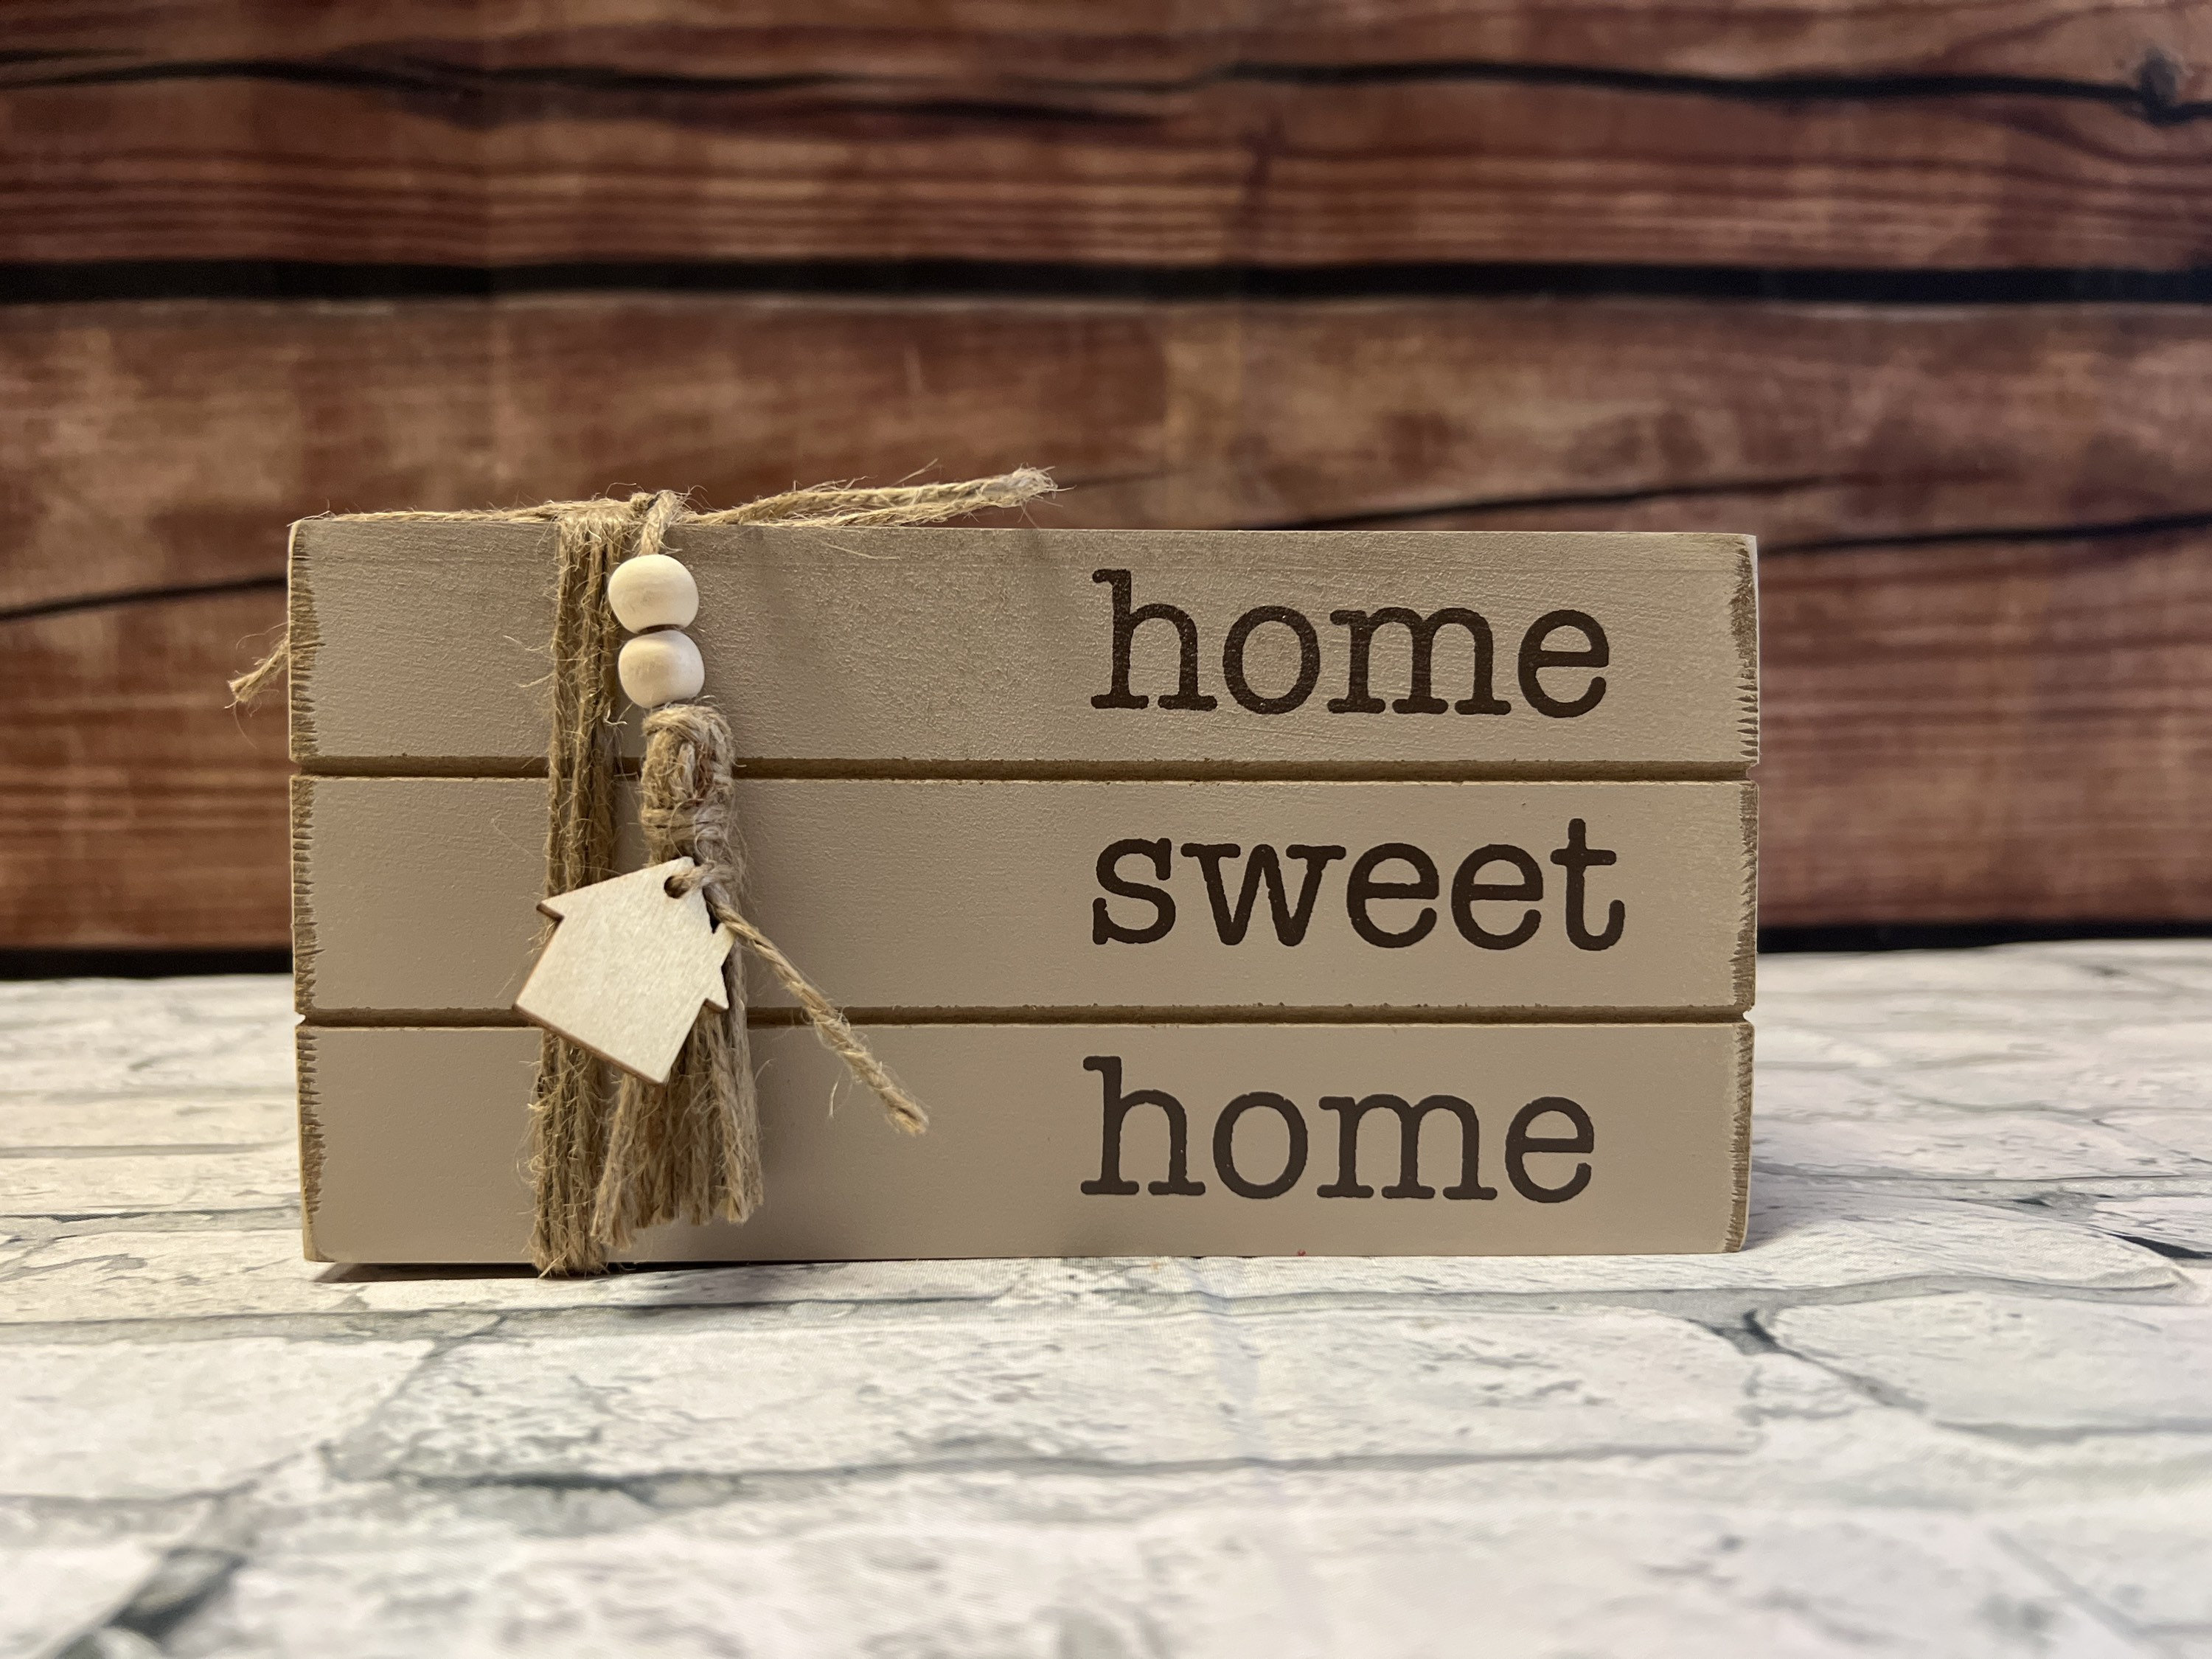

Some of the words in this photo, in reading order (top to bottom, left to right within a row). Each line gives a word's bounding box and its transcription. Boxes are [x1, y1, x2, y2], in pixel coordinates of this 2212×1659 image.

[1091, 568, 1610, 718] home
[1093, 818, 1625, 951] sweet
[1081, 1056, 1594, 1203] home
